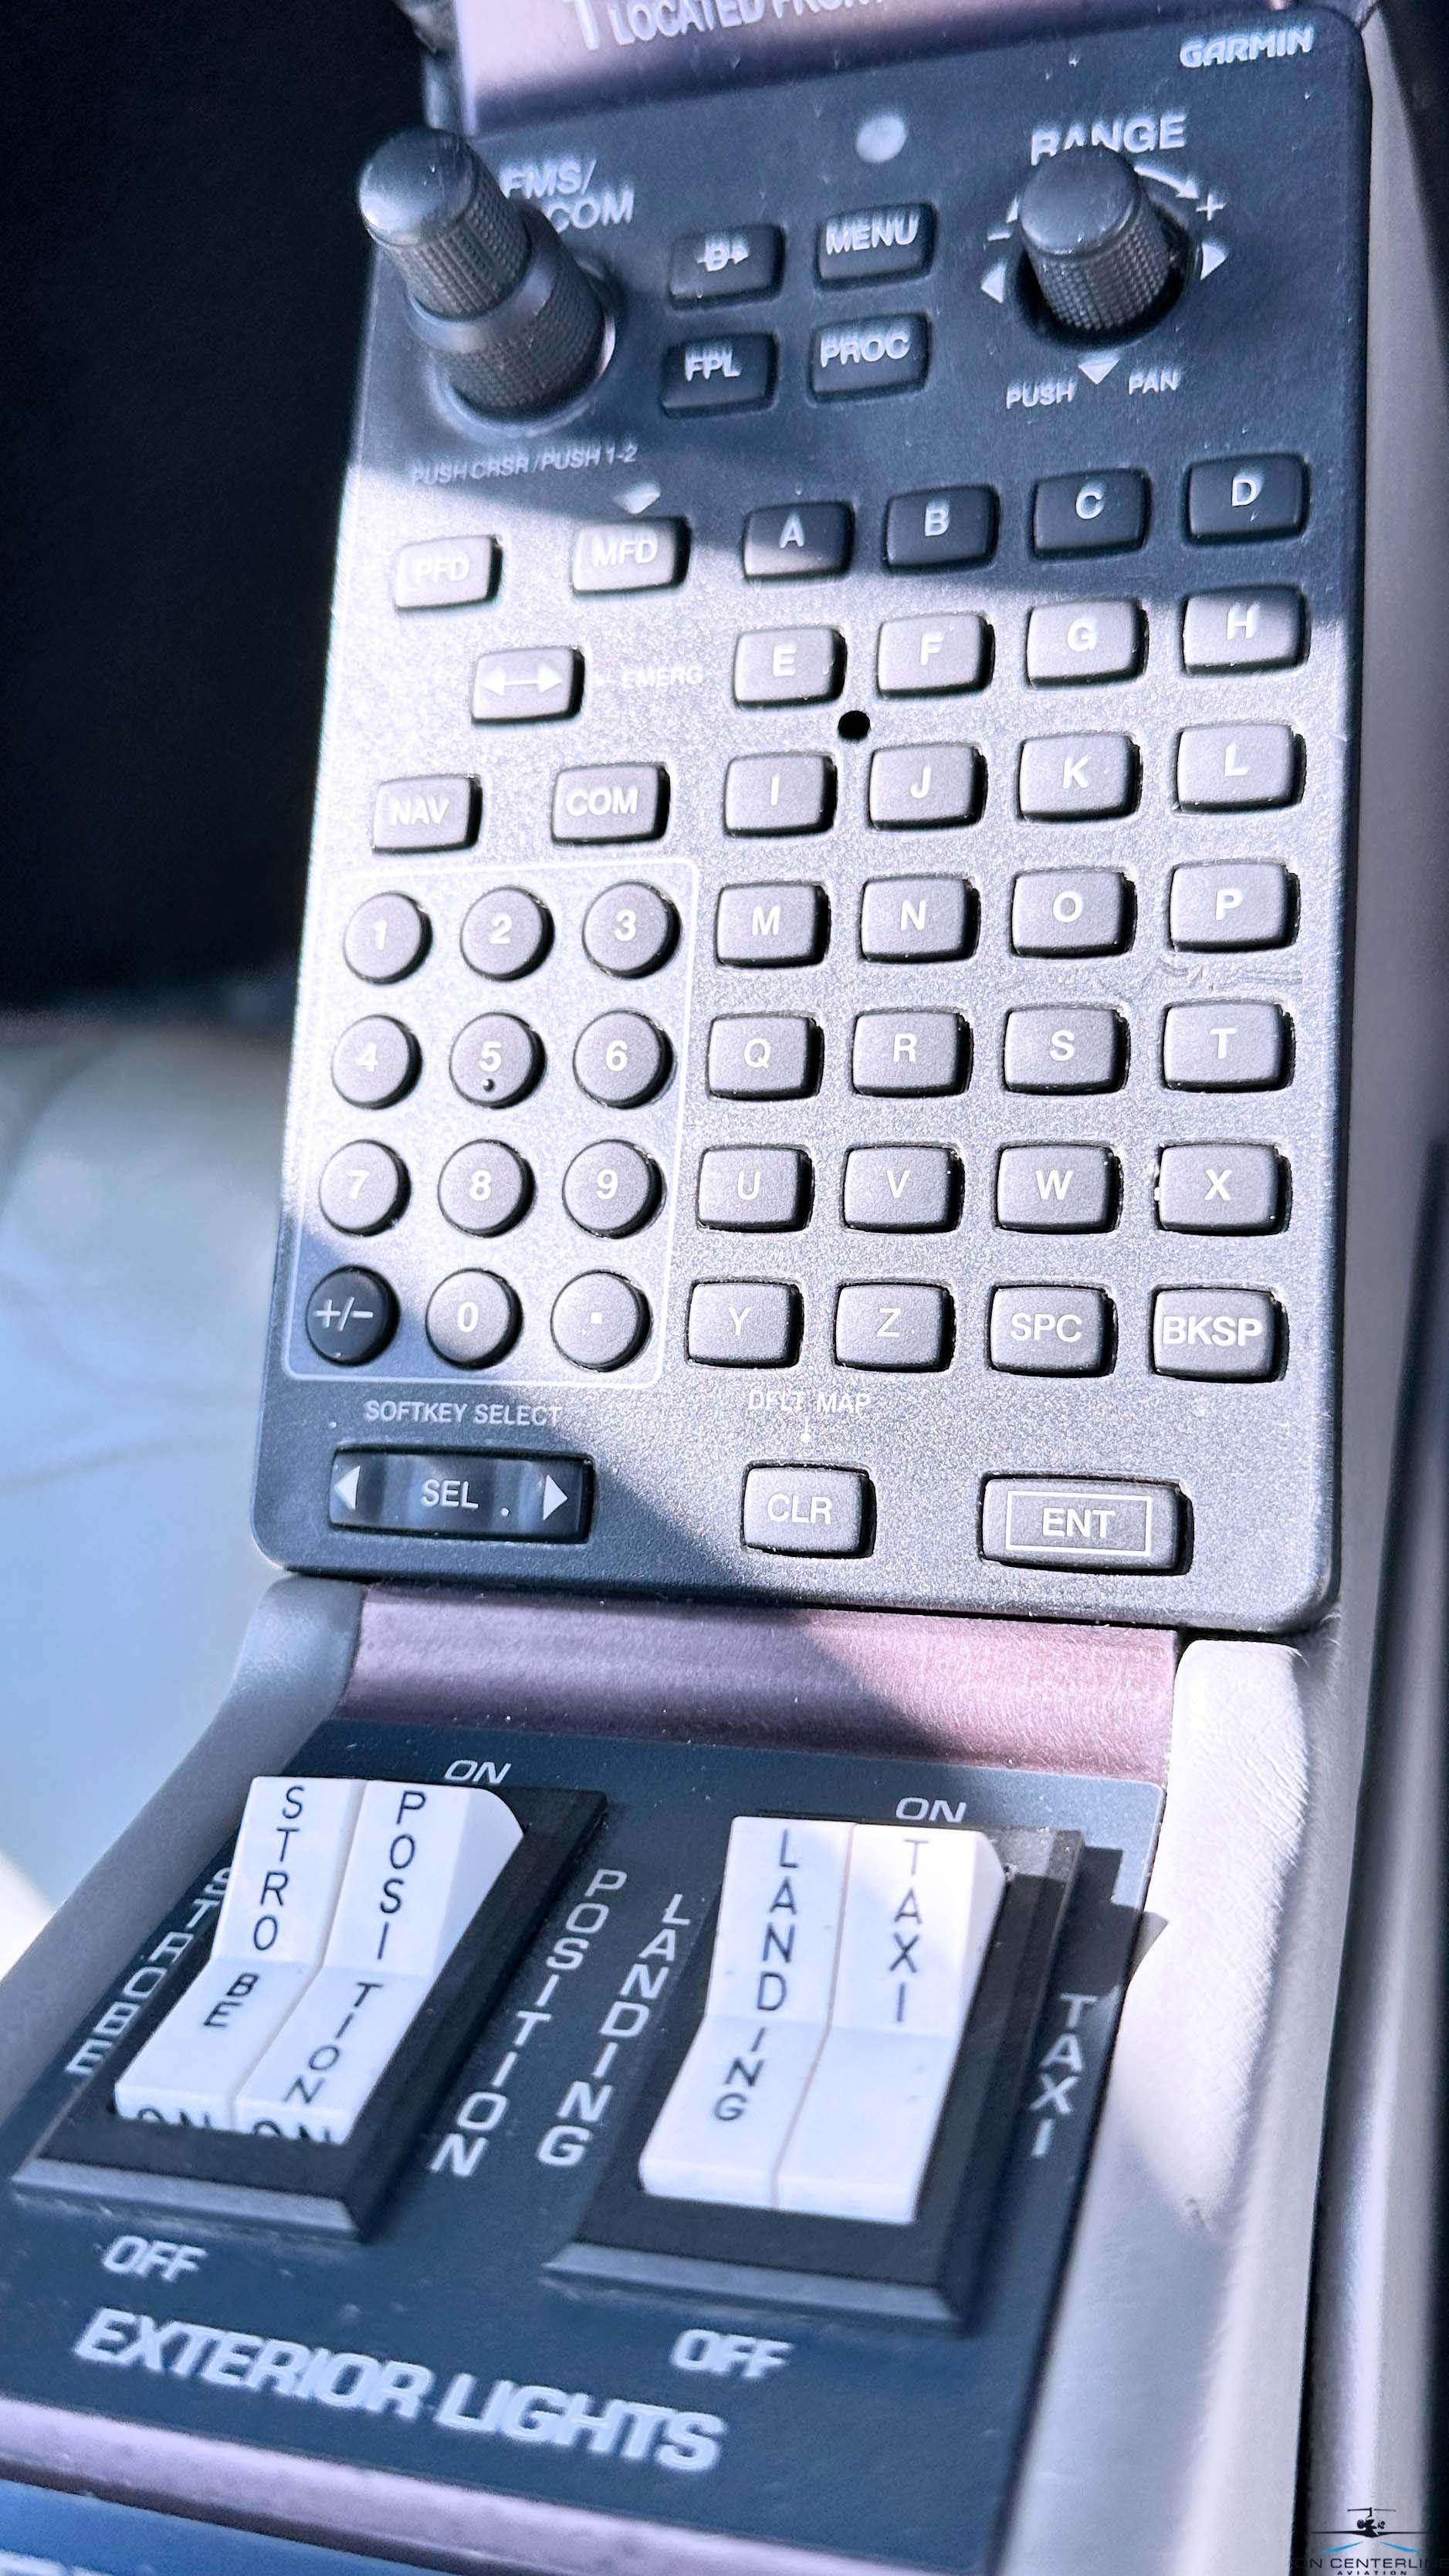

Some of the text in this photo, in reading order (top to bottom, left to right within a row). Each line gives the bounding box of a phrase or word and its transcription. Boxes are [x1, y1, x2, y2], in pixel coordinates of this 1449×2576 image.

[1180, 26, 1314, 68] GARMIN
[1030, 113, 1187, 166] RANGE
[500, 157, 597, 199] FMS/
[825, 214, 920, 256] MENU
[684, 347, 741, 382] FPL
[820, 332, 912, 368] PROC
[1005, 371, 1181, 411] PUSH PAN
[411, 463, 467, 486] PUSH
[606, 442, 638, 465] 1-2
[1075, 488, 1105, 520] C
[1231, 477, 1260, 508] D
[779, 512, 805, 549] A
[924, 506, 951, 538] B
[591, 536, 659, 567] MFD
[414, 553, 471, 585] PFD
[1066, 621, 1099, 653] G
[1226, 606, 1259, 641] H
[772, 644, 797, 679] E
[919, 631, 946, 667] F
[621, 664, 704, 690] EMERG
[1061, 756, 1092, 790] K
[1223, 744, 1251, 777] L
[771, 777, 780, 807] I
[909, 765, 933, 799] J
[389, 795, 449, 827] NAV
[566, 786, 639, 818] COM
[751, 905, 781, 936] M
[899, 900, 926, 931] N
[1052, 890, 1083, 923] O
[1215, 889, 1244, 921] P
[374, 919, 388, 951] 1
[489, 913, 513, 945] 2
[613, 909, 638, 943] 3
[357, 1042, 379, 1072] 4
[479, 1041, 503, 1072] 5
[604, 1039, 628, 1071] 6
[743, 1038, 771, 1070] Q
[892, 1033, 917, 1063] R
[1049, 1030, 1076, 1062] S
[1209, 1027, 1237, 1060] T
[346, 1169, 371, 1200] 7
[468, 1170, 493, 1202] 8
[595, 1168, 619, 1201] 9
[736, 1170, 760, 1201] U
[885, 1170, 911, 1200] V
[1035, 1169, 1075, 1201] W
[1204, 1168, 1233, 1201] X
[314, 1296, 374, 1332] +/-
[456, 1302, 479, 1333] 0
[727, 1307, 751, 1337] Y
[876, 1307, 902, 1339] Z
[1010, 1313, 1082, 1343] SPC
[1162, 1315, 1264, 1347] BKSP
[364, 1399, 562, 1427] SOFTKEY SELECT
[747, 1390, 872, 1413] DFLT MAP
[420, 1479, 479, 1510] SEL
[766, 1493, 834, 1525] CLR
[1042, 1507, 1116, 1538] ENT
[445, 1759, 511, 1784] ON
[895, 1796, 967, 1823] ON
[889, 1837, 930, 2023] TAXI
[715, 1828, 799, 2122] LANDING
[430, 1868, 628, 2177] POSITION
[537, 1893, 691, 2167] LANDING
[1029, 1993, 1097, 2158] TAXI
[102, 2234, 208, 2283] OFF
[671, 2328, 794, 2379] OFF
[73, 2308, 728, 2472] EXTERIOR LIGHTS
